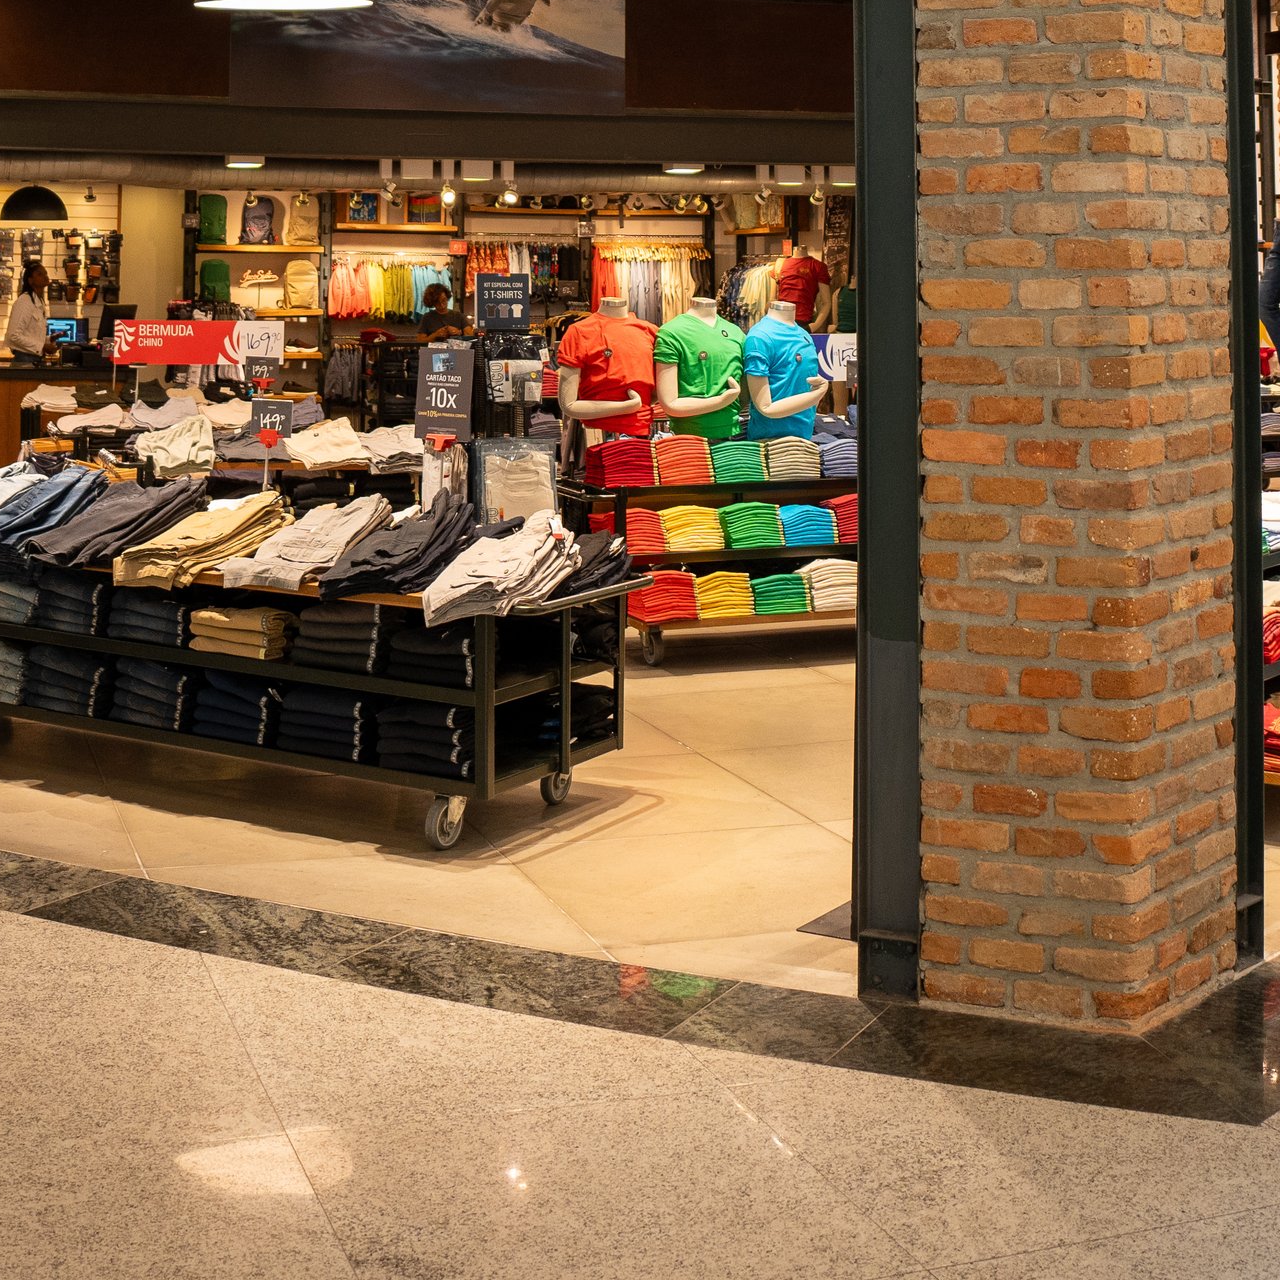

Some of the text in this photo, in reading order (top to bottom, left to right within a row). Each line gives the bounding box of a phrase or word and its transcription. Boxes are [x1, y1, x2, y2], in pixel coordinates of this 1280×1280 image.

[483, 290, 523, 299] 3 T-SHIRTS
[138, 324, 194, 337] BERMUDA
[138, 337, 163, 347] CHINO
[425, 373, 462, 383] CARTÃO TACO
[490, 362, 505, 402] TACO
[427, 410, 438, 418] 10%
